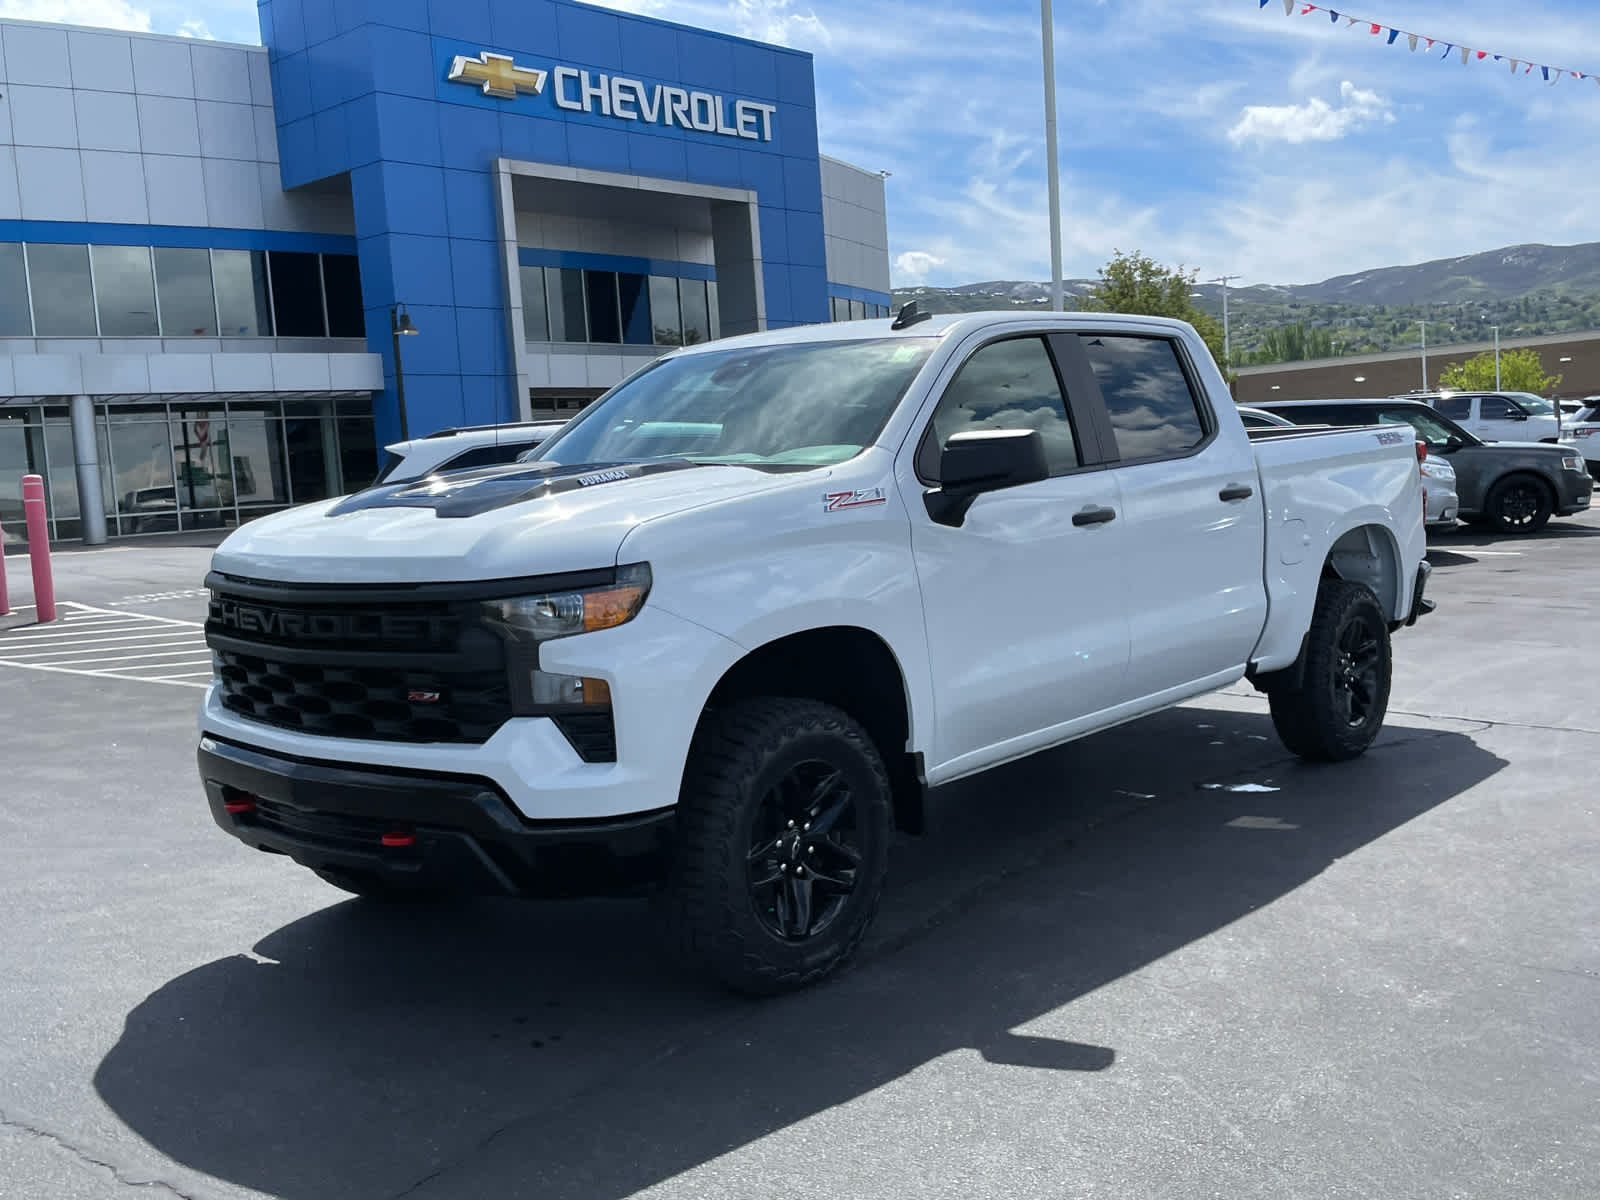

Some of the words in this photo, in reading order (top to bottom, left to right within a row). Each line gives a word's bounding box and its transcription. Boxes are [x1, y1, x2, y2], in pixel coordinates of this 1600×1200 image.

[554, 65, 776, 141] CHEVROLET
[579, 470, 630, 487] DURAMAX
[824, 487, 887, 512] Z71
